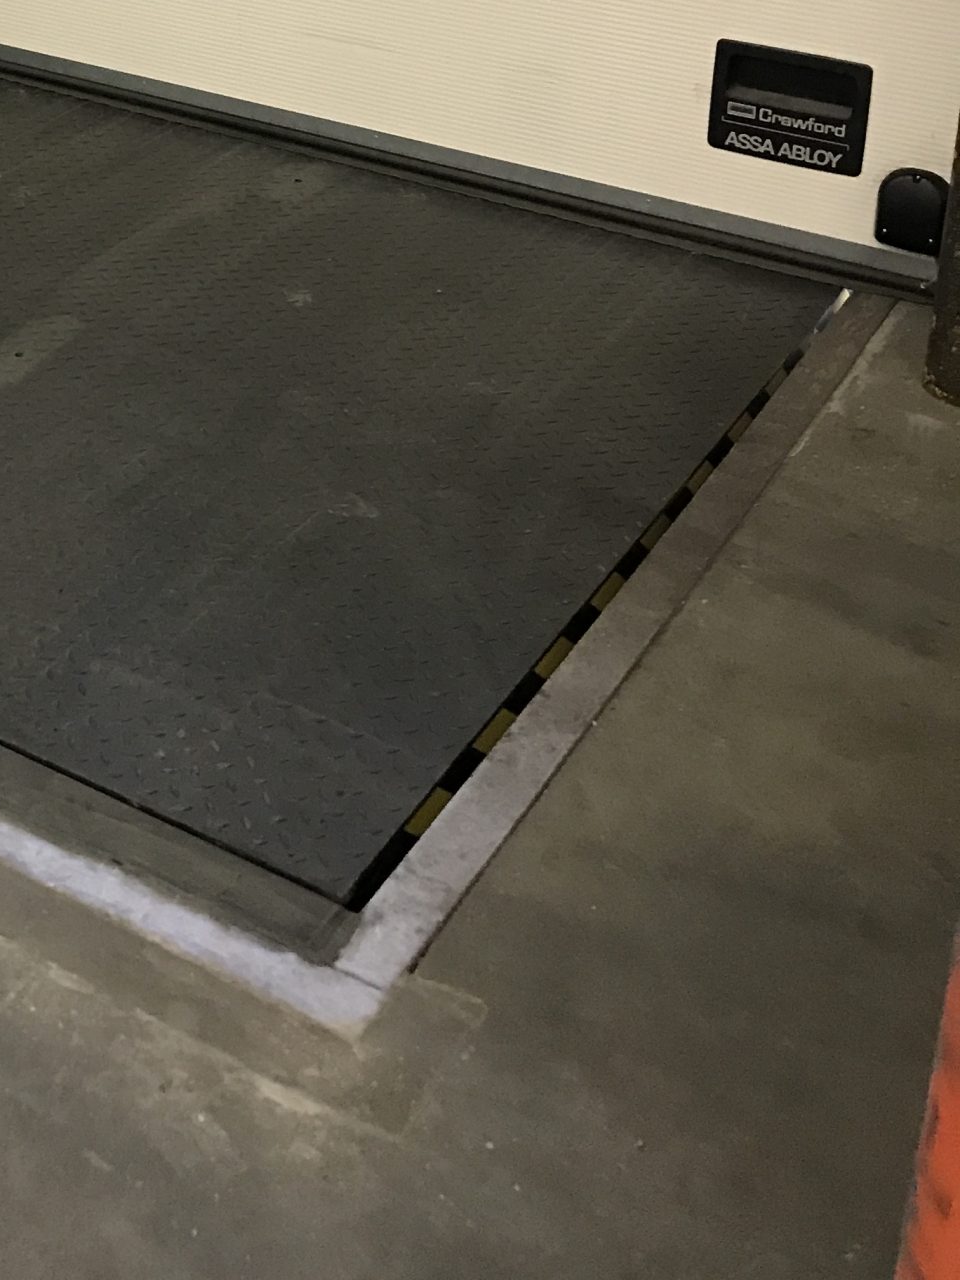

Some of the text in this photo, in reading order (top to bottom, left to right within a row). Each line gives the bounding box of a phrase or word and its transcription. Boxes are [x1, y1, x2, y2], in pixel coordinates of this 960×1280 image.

[758, 107, 847, 138] Crawford
[724, 131, 843, 169] ASSA ABLOY
